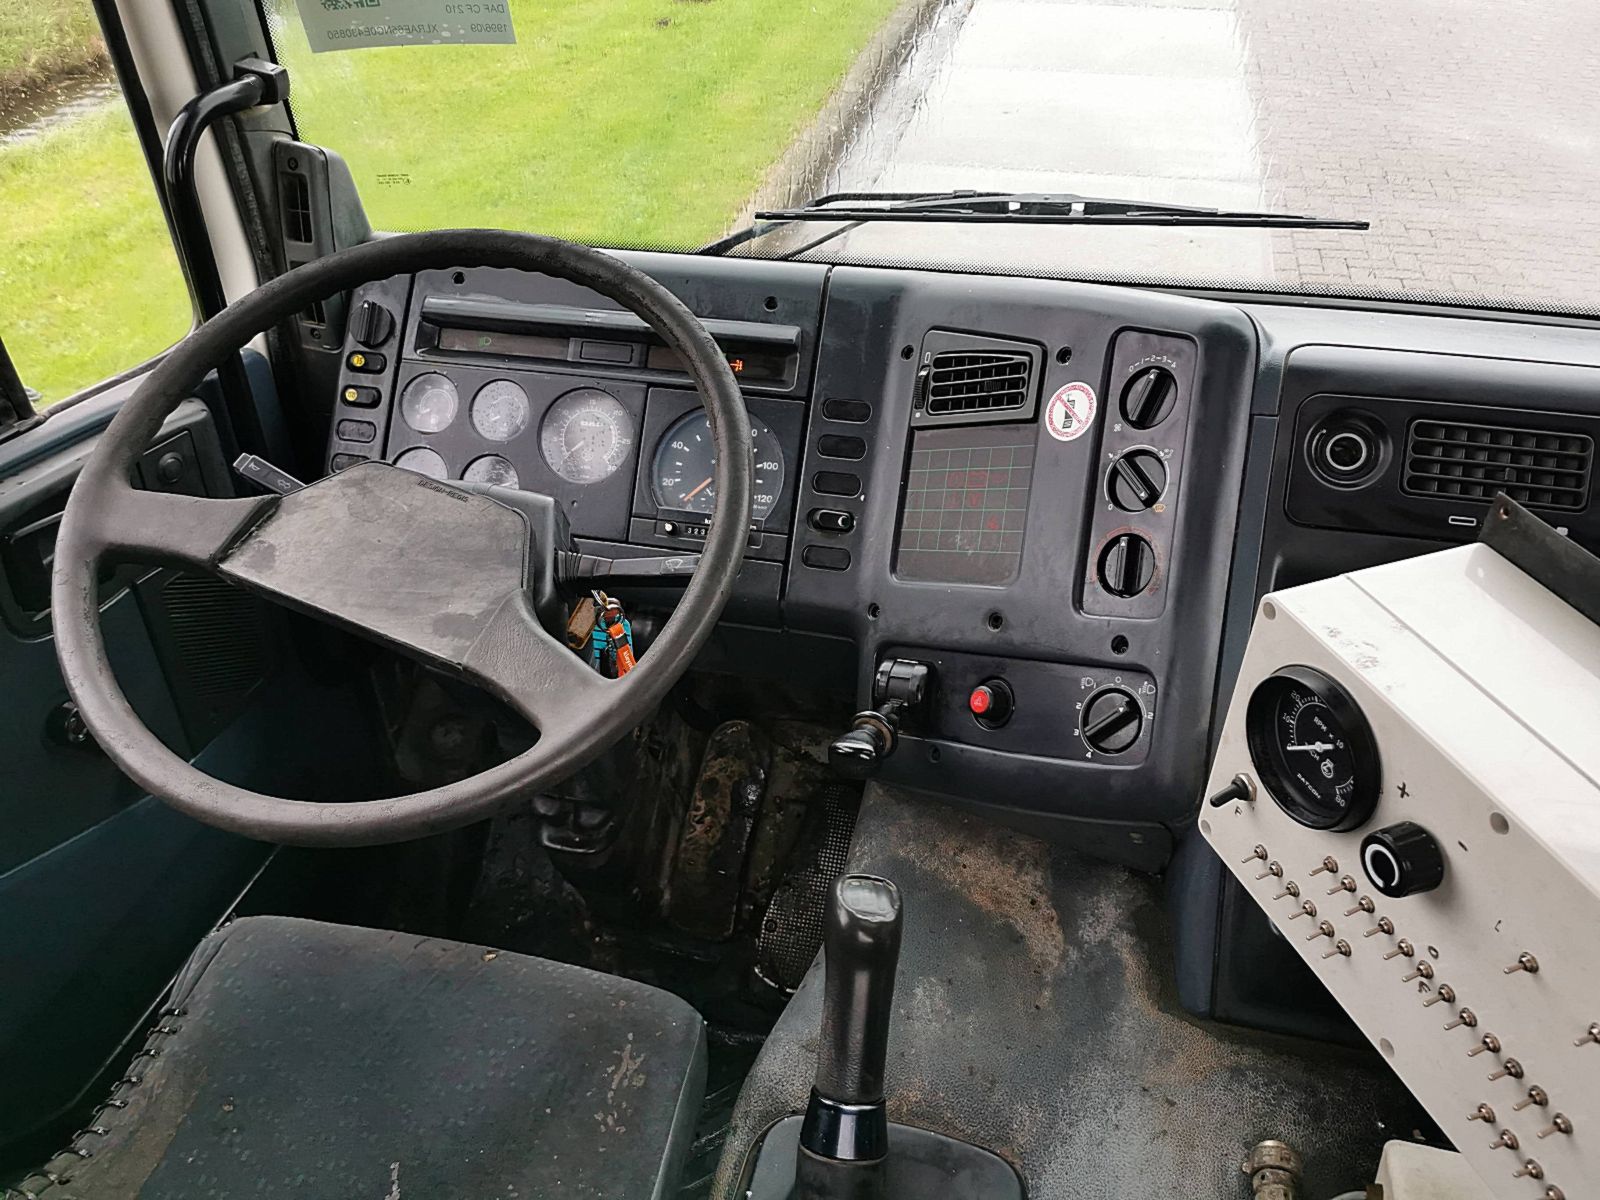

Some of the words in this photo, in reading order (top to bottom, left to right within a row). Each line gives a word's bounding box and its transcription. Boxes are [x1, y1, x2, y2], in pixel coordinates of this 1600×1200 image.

[671, 440, 684, 450] 40
[762, 461, 779, 471] 100
[662, 477, 675, 487] 20
[758, 494, 774, 504] 120
[1290, 690, 1301, 701] 20
[1282, 712, 1291, 723] 10
[1313, 715, 1328, 733] RPM
[1335, 739, 1345, 749] 10
[1335, 793, 1346, 807] 80
